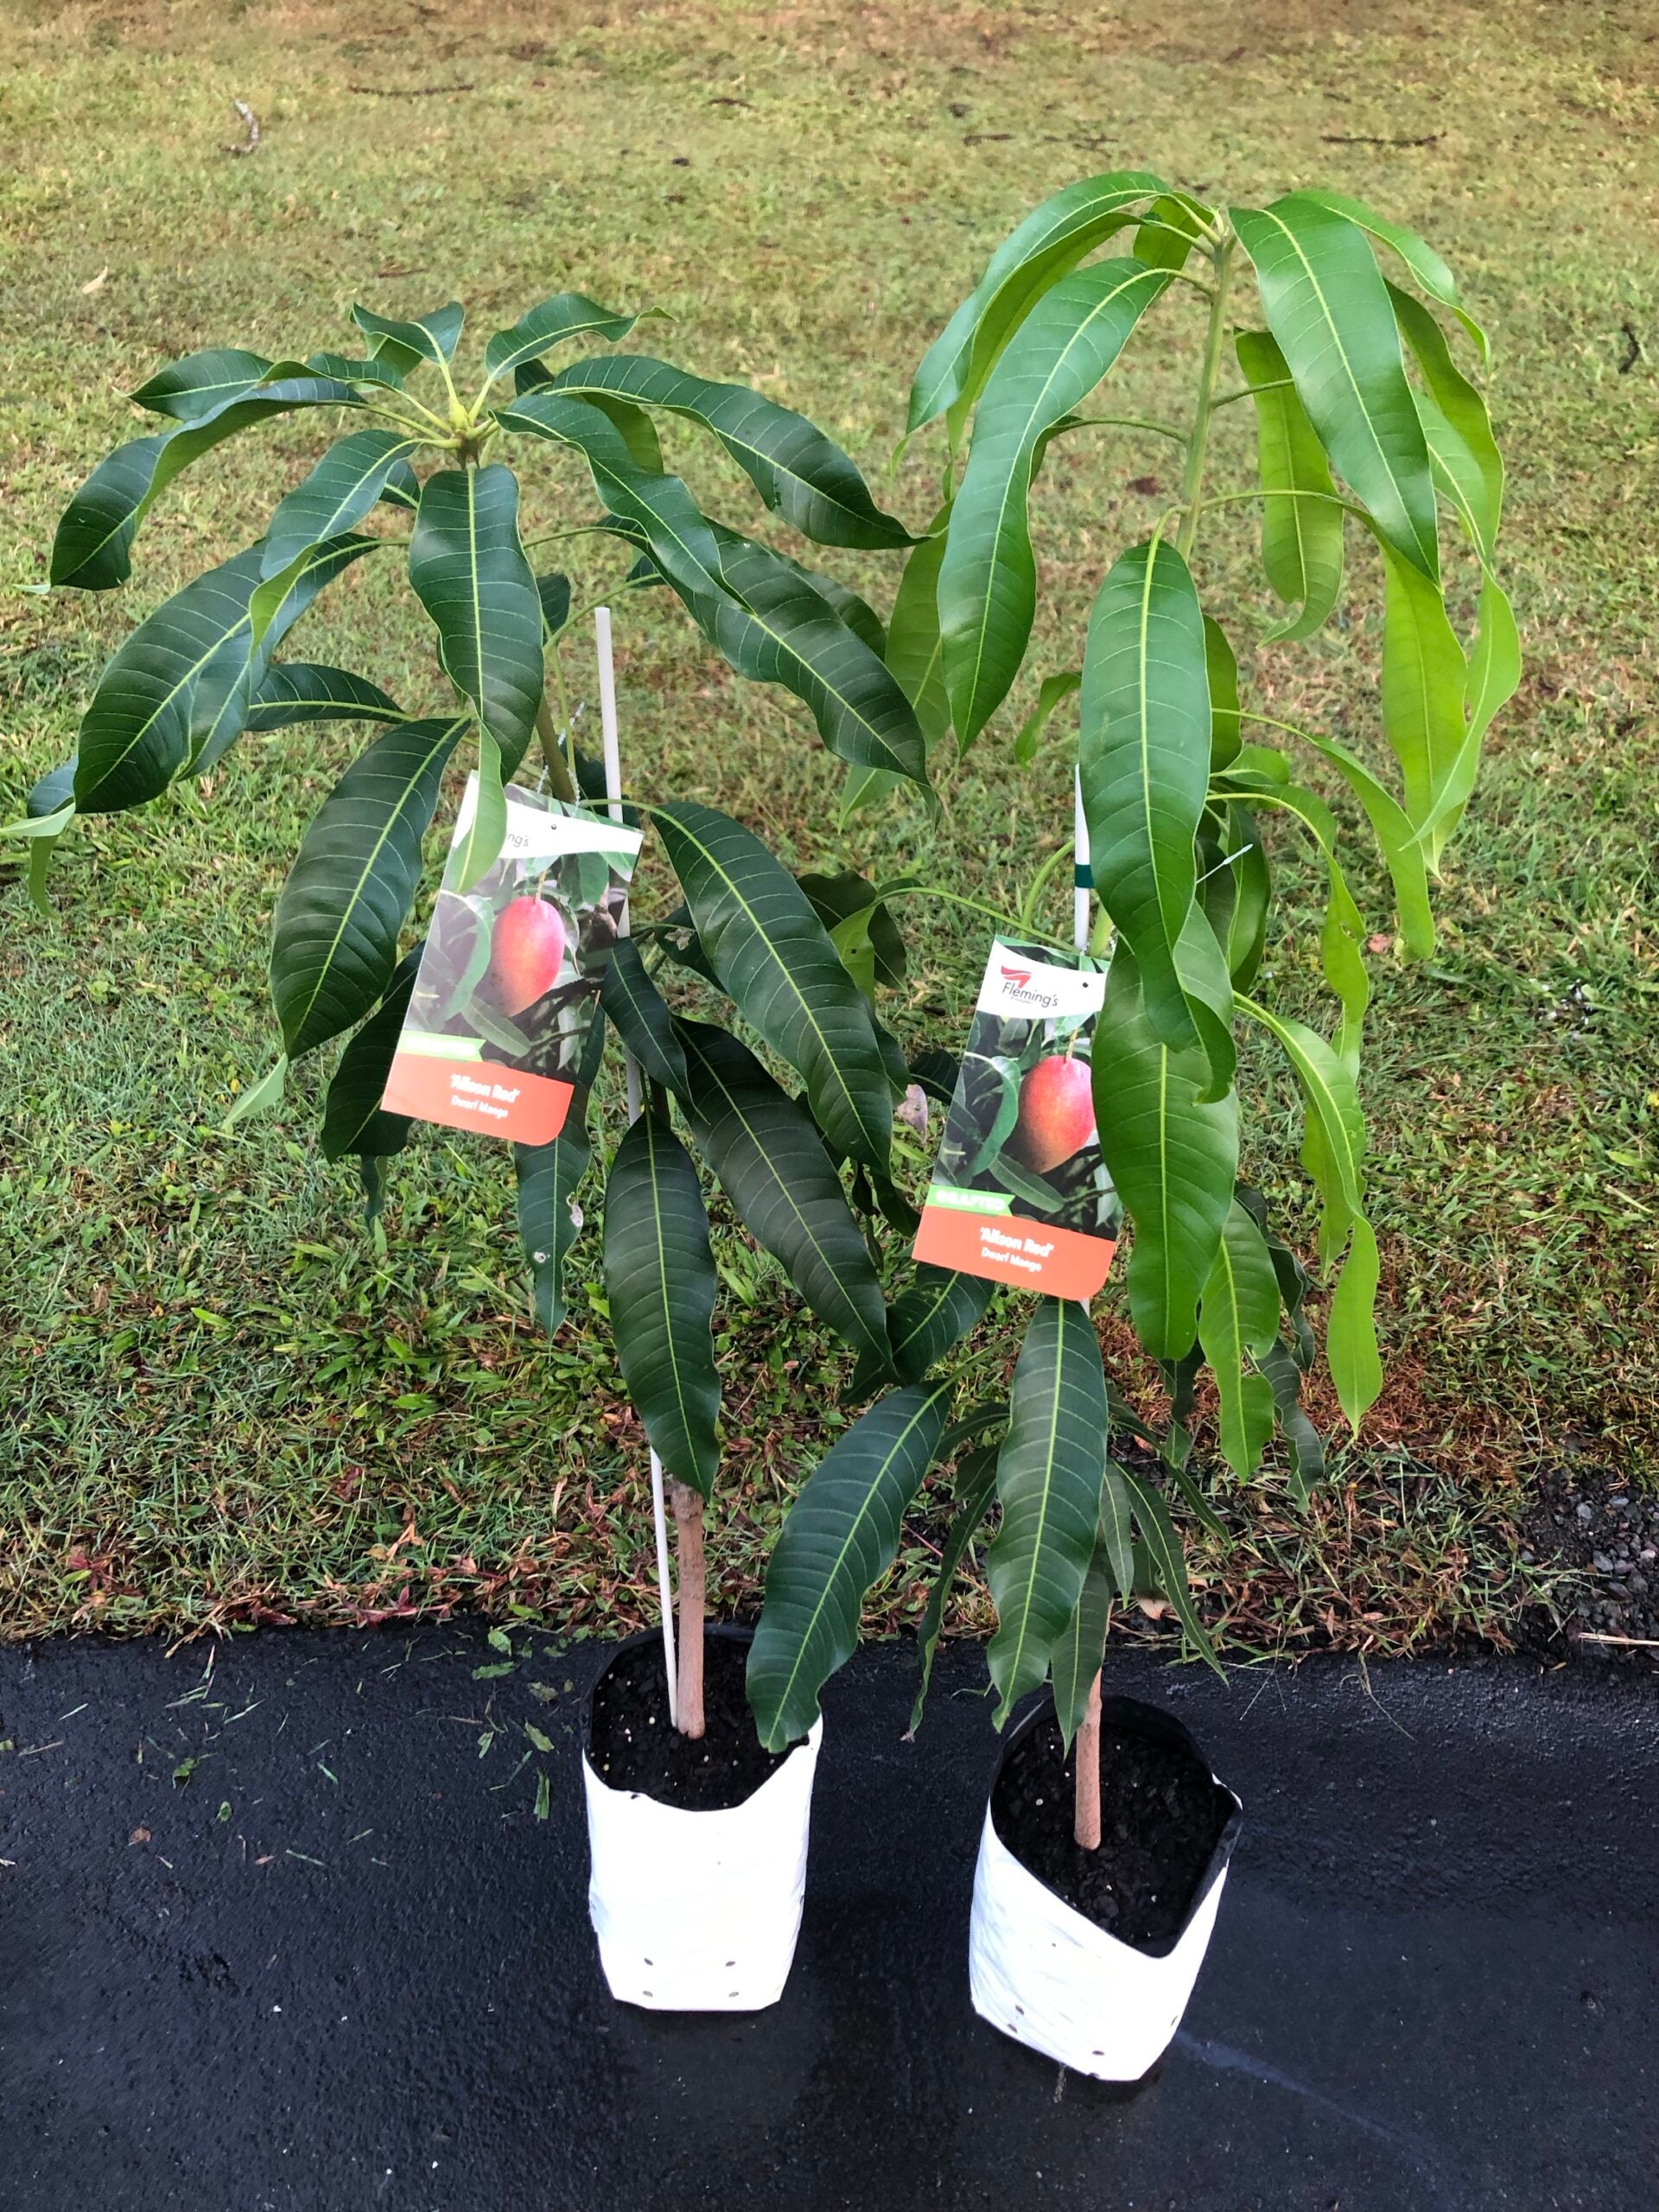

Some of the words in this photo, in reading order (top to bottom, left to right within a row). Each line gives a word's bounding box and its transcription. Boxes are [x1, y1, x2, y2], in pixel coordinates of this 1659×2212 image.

[1002, 982, 1058, 1008] Fleming's
[936, 1190, 1006, 1211] GRAFTED
[981, 1247, 1010, 1262] Dwarf
[1009, 1254, 1042, 1272] Mango
